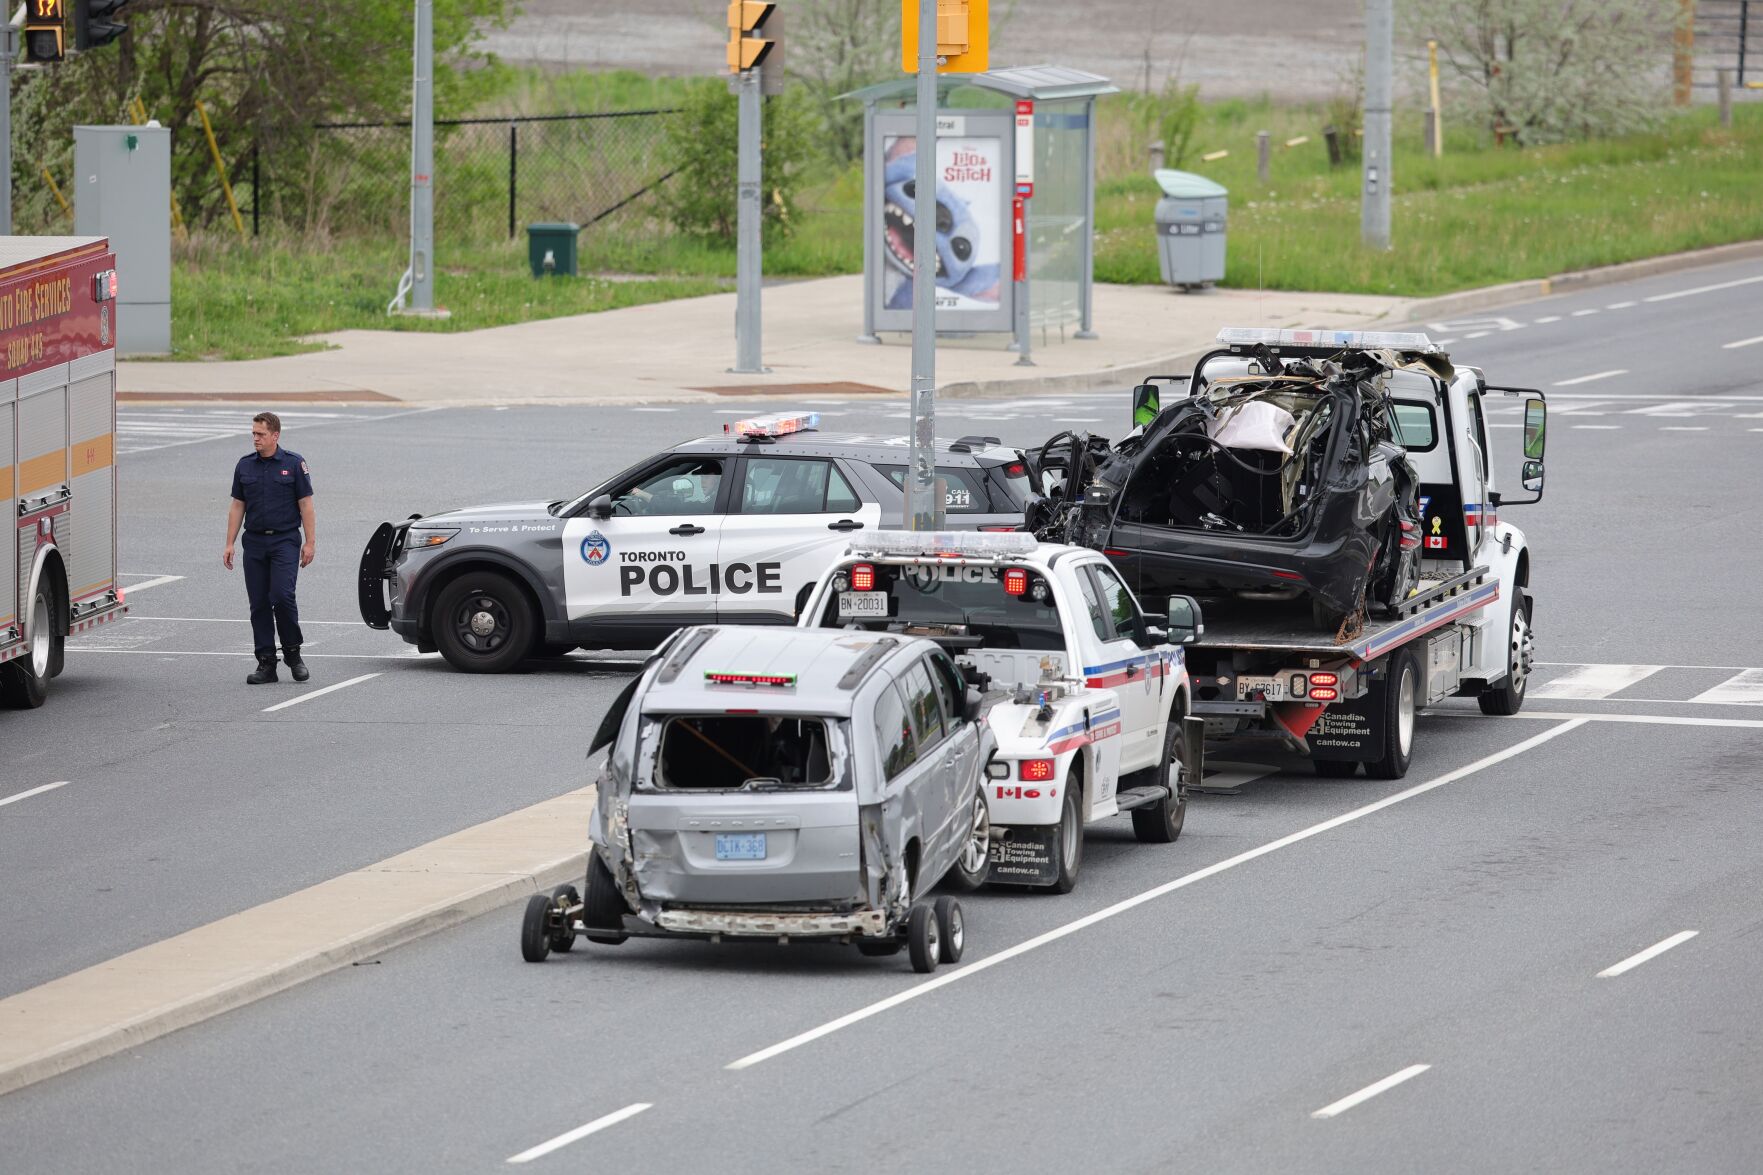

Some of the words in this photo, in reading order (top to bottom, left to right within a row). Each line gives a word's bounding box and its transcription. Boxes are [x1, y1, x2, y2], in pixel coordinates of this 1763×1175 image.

[7, 337, 29, 369] SQUAD
[482, 525, 509, 533] Serve
[521, 524, 556, 532] Protect
[619, 551, 686, 562] TORONTO
[899, 565, 999, 584] POLICE
[620, 562, 782, 597] POLICE
[1325, 712, 1366, 721] Canadian
[1325, 720, 1356, 728] Towing
[1325, 726, 1370, 736] Equipment
[1316, 739, 1361, 747] cantow.ca
[1005, 841, 1045, 850] Canadian
[1005, 849, 1035, 857] Towing
[1005, 854, 1049, 864] Equipment
[997, 866, 1040, 875] cantow.ca
